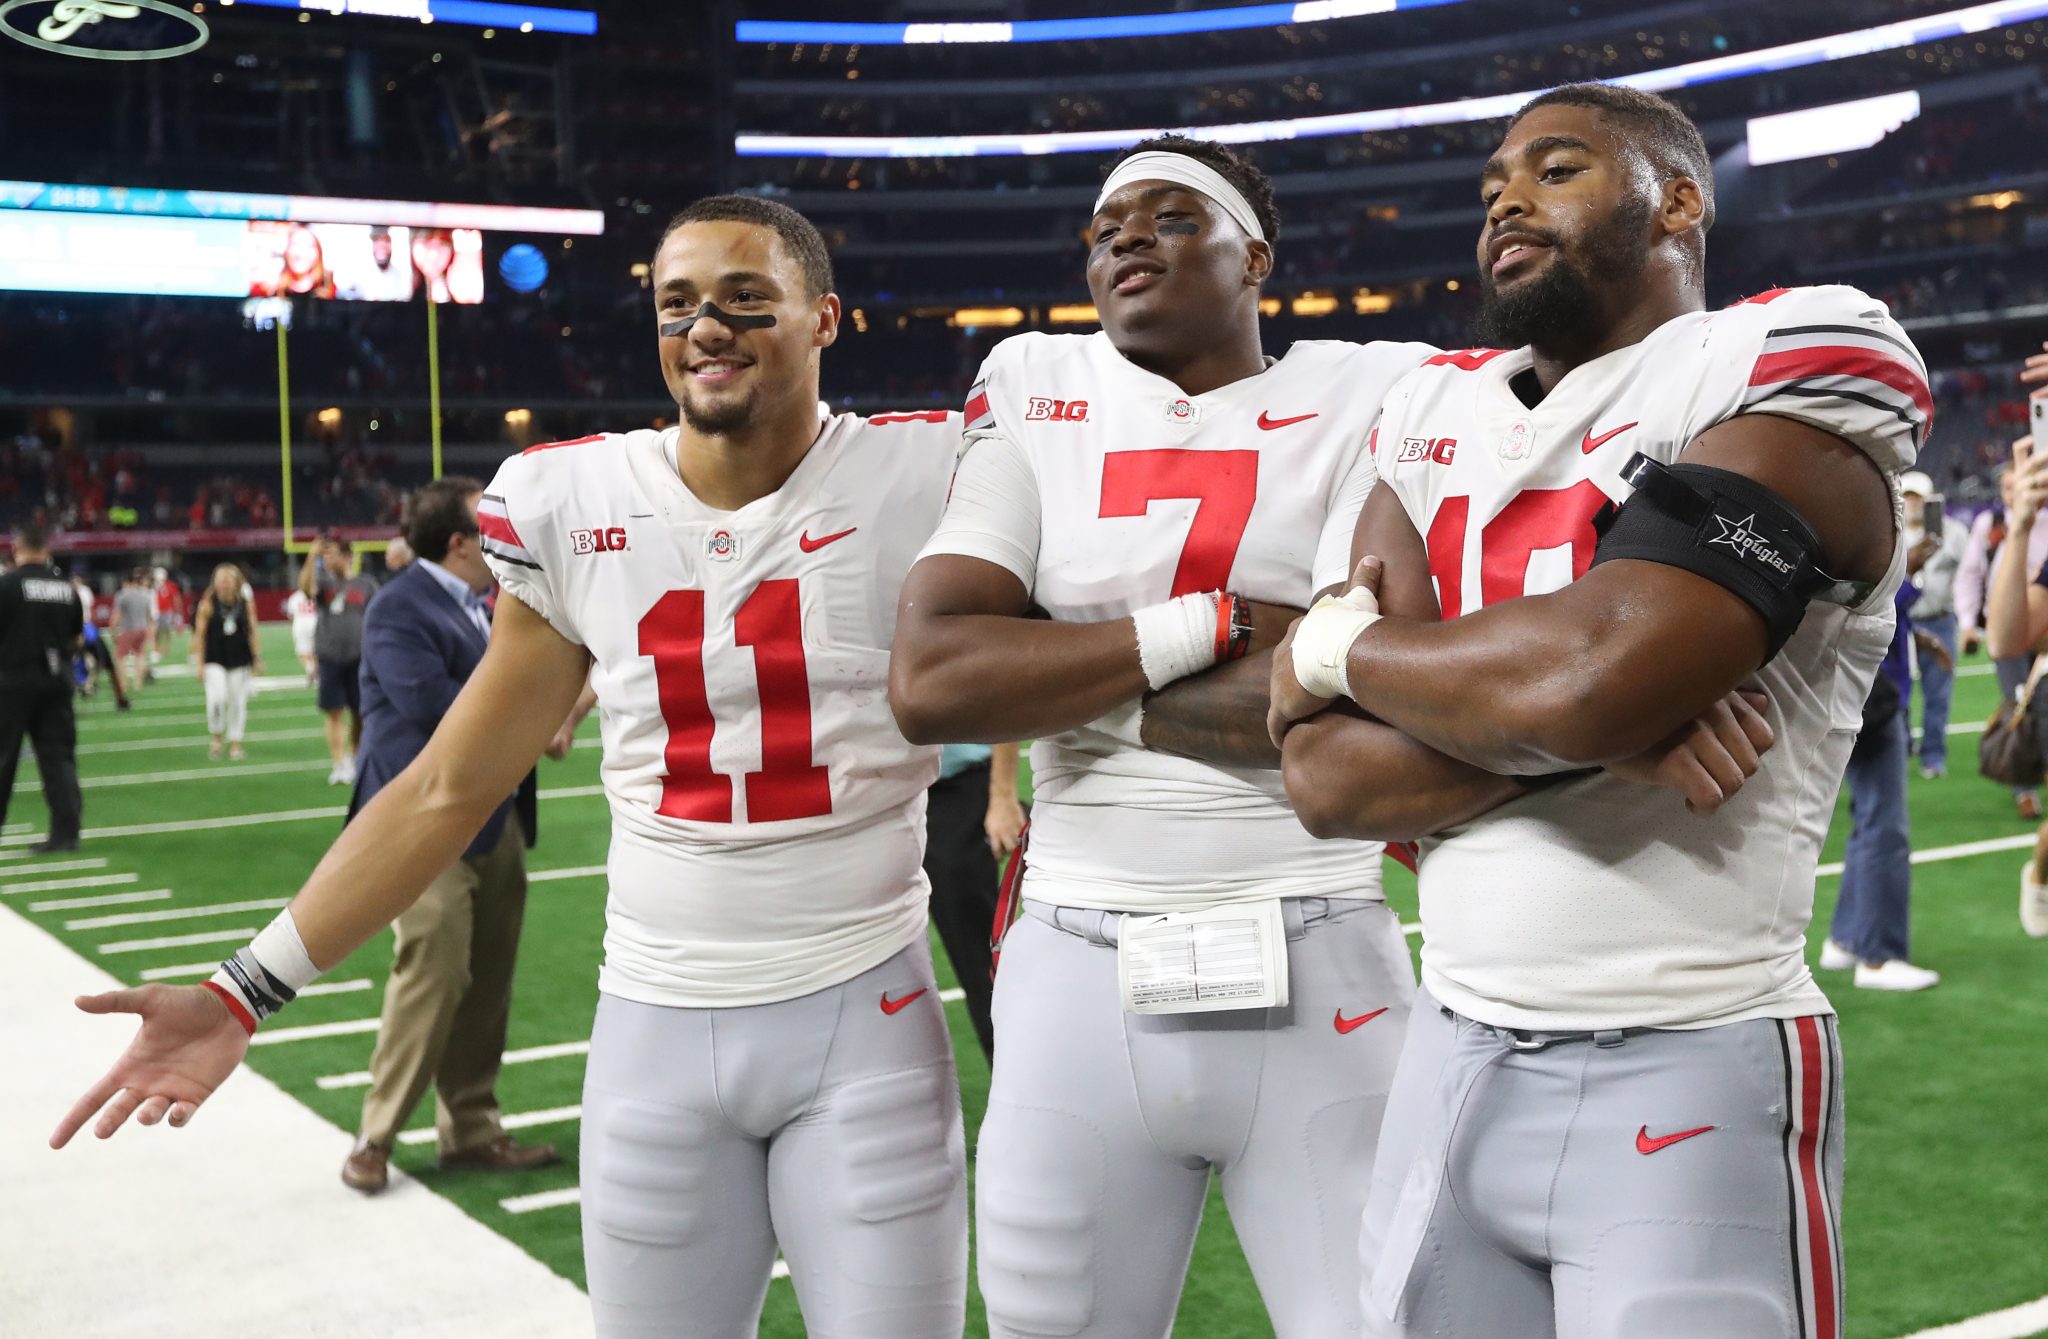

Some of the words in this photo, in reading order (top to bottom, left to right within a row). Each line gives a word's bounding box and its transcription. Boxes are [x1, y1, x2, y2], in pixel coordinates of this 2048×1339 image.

[1097, 448, 1260, 601] 7
[1730, 527, 1793, 574] Douglas
[637, 578, 833, 823] 11
